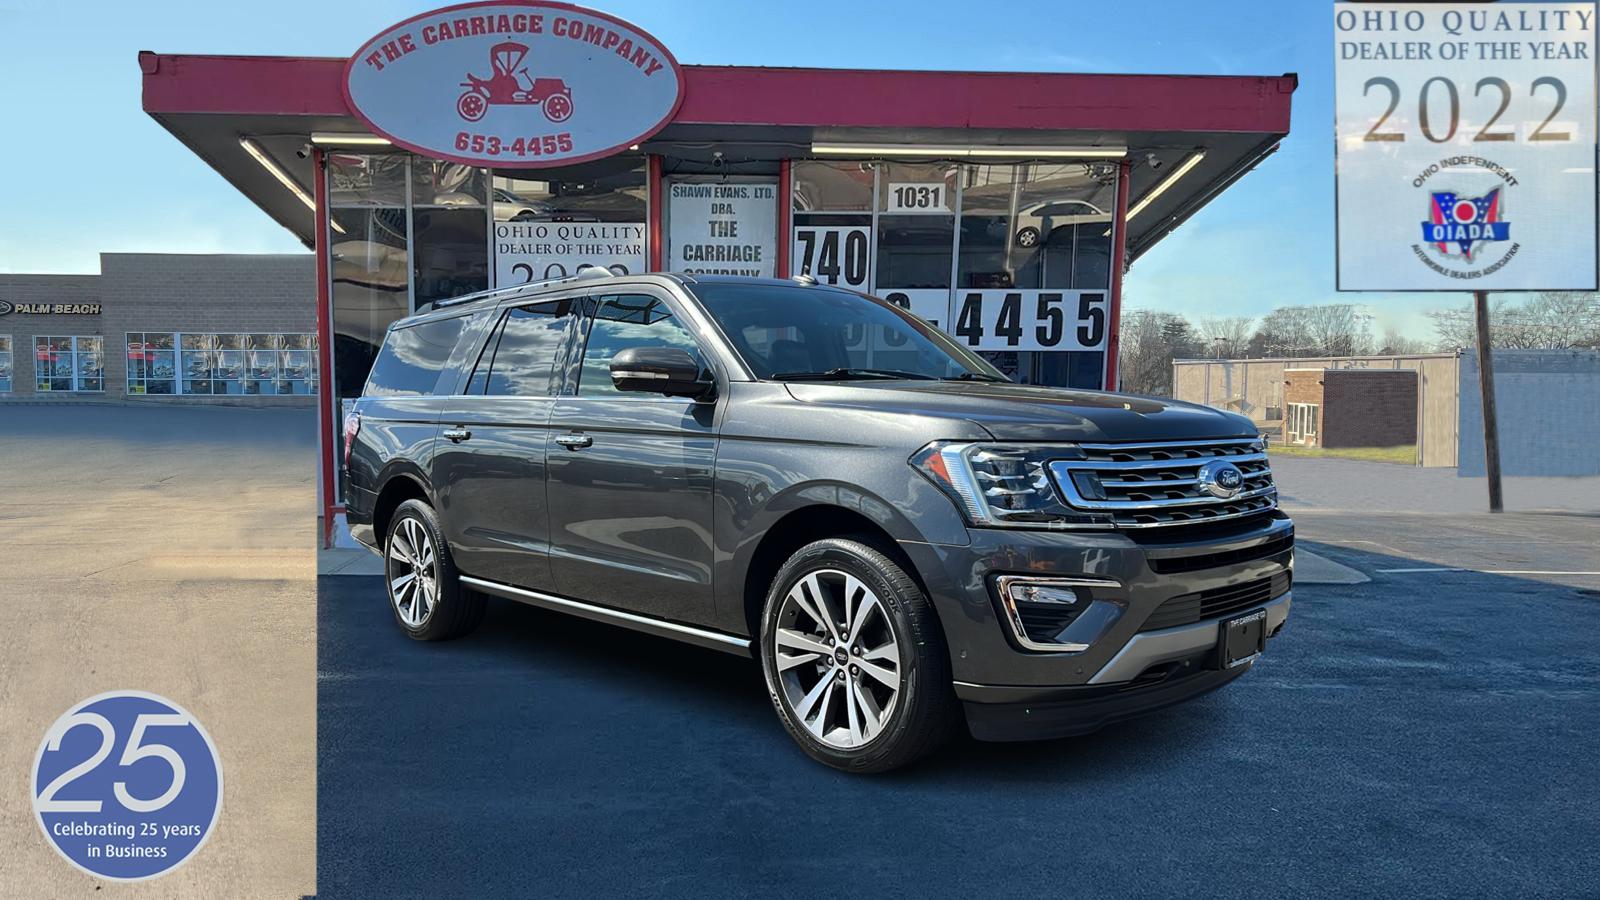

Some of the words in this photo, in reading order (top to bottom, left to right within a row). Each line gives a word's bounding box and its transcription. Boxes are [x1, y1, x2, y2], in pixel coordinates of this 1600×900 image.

[1336, 10, 1425, 31] OHIO
[1442, 10, 1593, 35] QUALITY
[365, 33, 418, 72] THE
[422, 14, 545, 46] CARRIAGE
[552, 16, 665, 78] COMPANY
[1340, 42, 1432, 60] DEALER
[1439, 42, 1469, 60] OF
[1475, 42, 1522, 60] THE
[1528, 42, 1589, 60] YEAR
[1363, 76, 1571, 143] 2022
[454, 131, 573, 156] 653-4455
[1413, 164, 1440, 188] OHIO
[1439, 156, 1519, 187] INDEPENDENT
[672, 186, 712, 198] SHAWN
[893, 186, 941, 208] 1031
[711, 203, 736, 215] DBA.
[497, 225, 549, 238] OHIO
[557, 226, 644, 240] QUALITY
[708, 220, 738, 238] THE
[1432, 224, 1495, 240] OIADA
[500, 244, 552, 254] DEALER
[555, 244, 574, 254] OF
[576, 244, 604, 254] THE
[607, 244, 642, 255] YEAR
[683, 244, 762, 262] CARRIAGE
[797, 230, 868, 286] 740
[15, 304, 51, 314] PALM
[55, 304, 100, 314] BEACH
